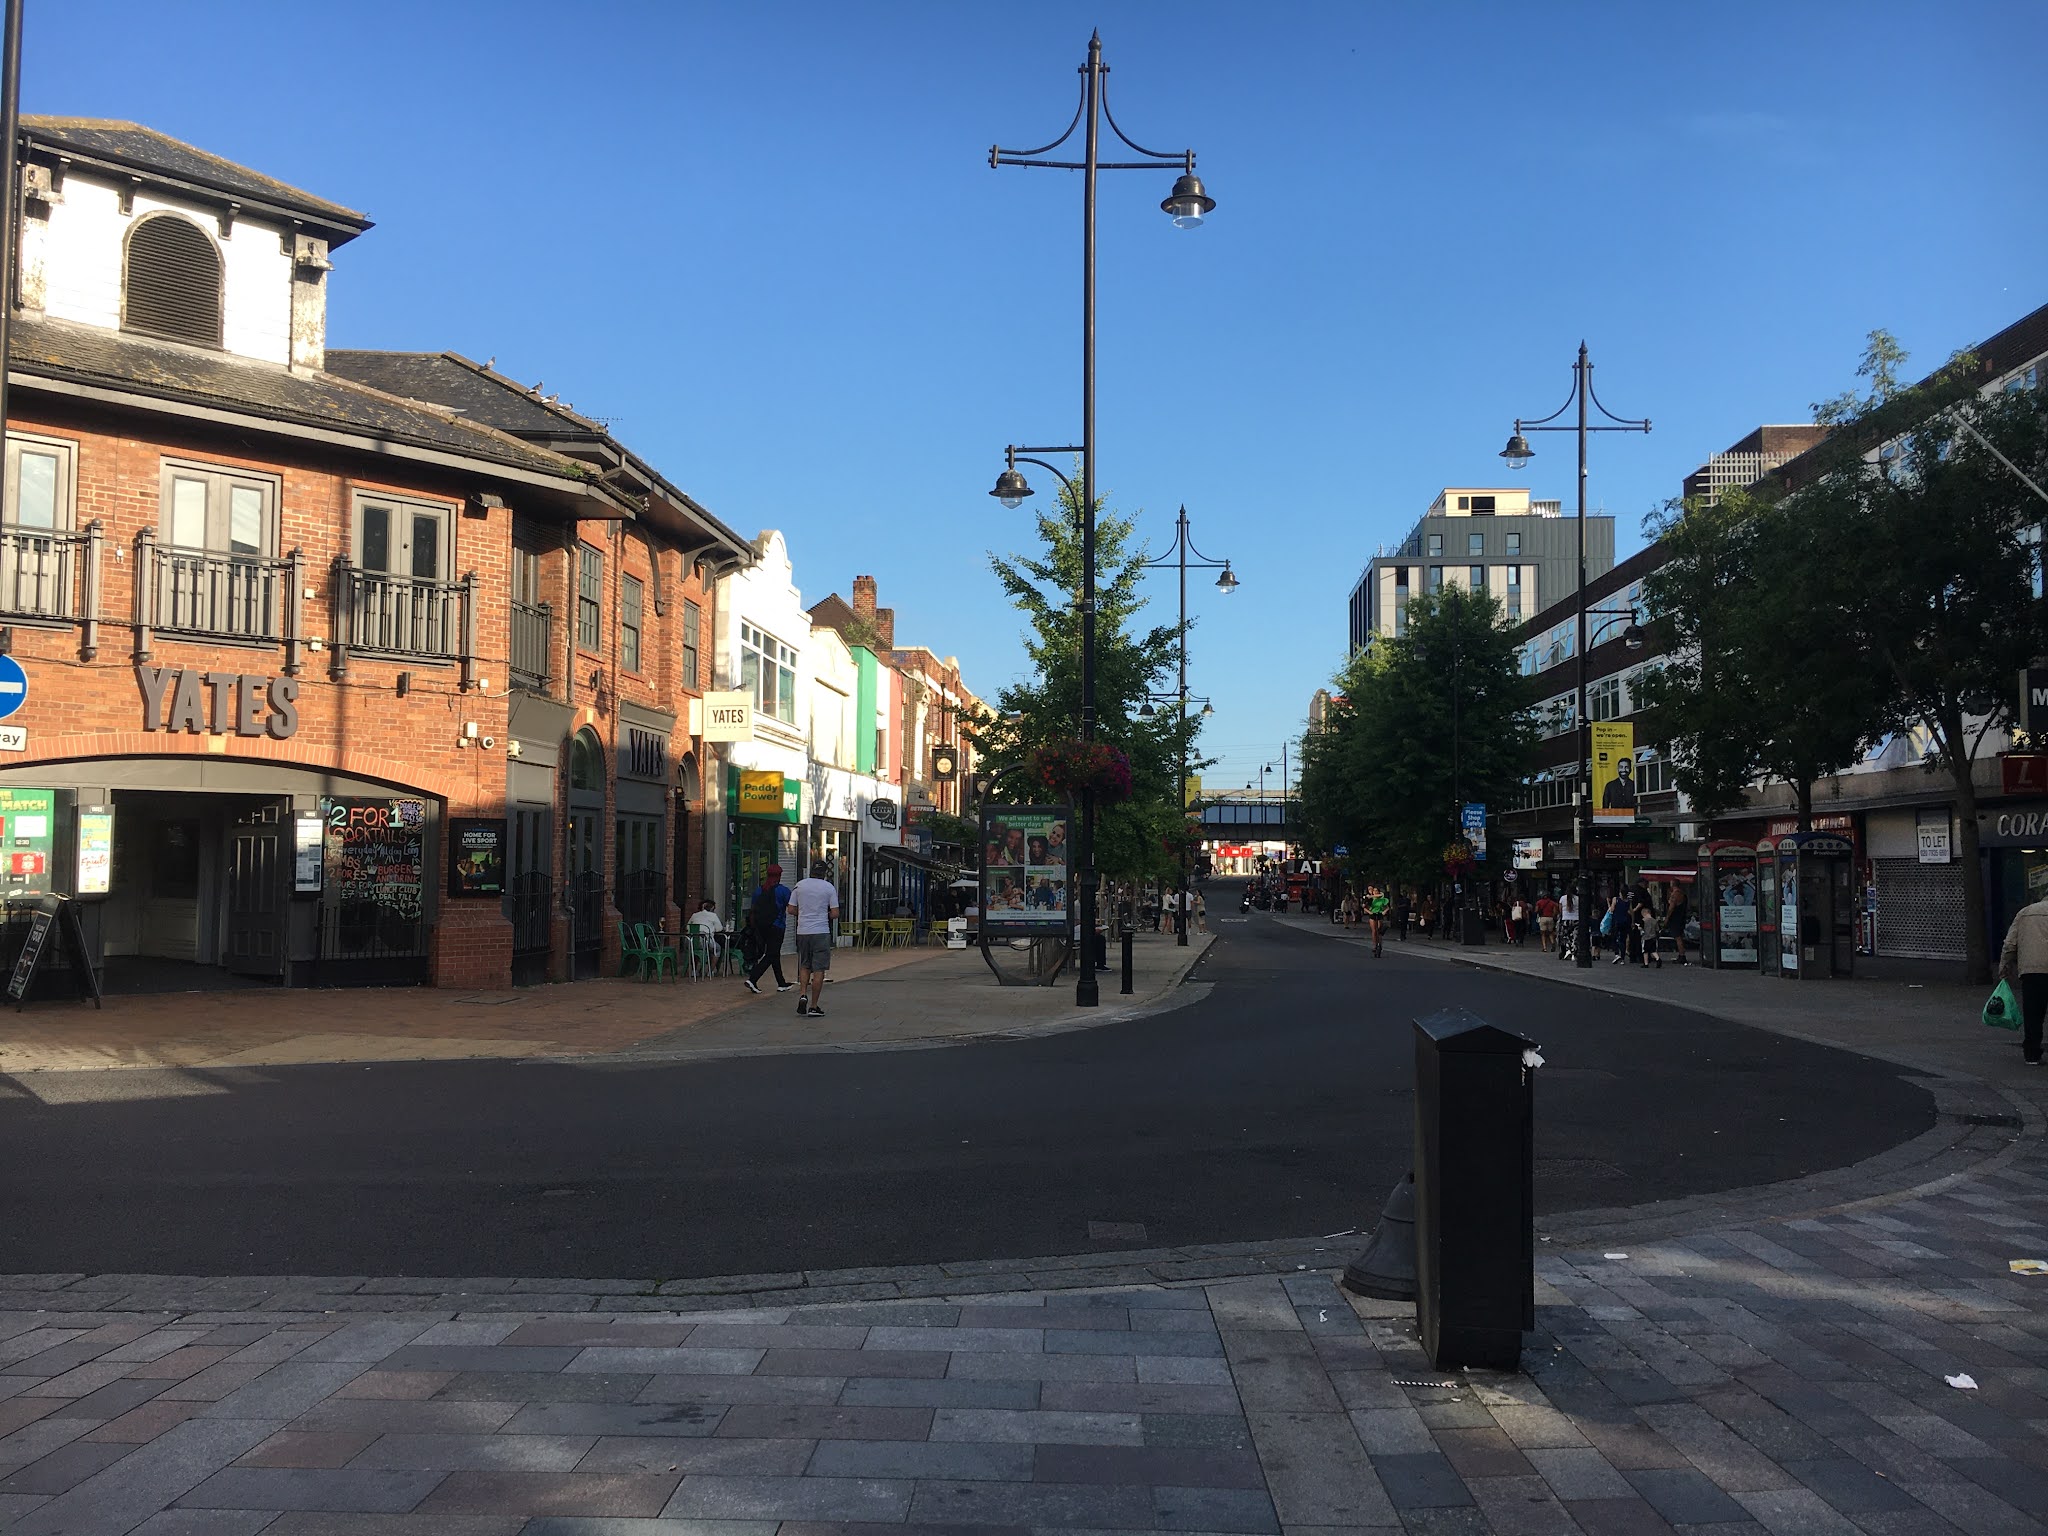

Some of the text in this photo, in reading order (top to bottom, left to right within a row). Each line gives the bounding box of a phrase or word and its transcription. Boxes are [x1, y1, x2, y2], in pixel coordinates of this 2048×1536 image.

[137, 665, 299, 740] YATES
[712, 709, 744, 723] YATES
[0, 734, 21, 746] ay
[629, 728, 665, 777] YATES
[744, 783, 778, 793] Paddy
[743, 792, 778, 801] Power
[1, 800, 48, 811] MATCH
[331, 806, 404, 828] 2 FOR 1
[333, 826, 407, 843] COCKTAILS
[1921, 836, 1946, 847] TO LET
[328, 868, 367, 880] 2 FOR £5
[378, 864, 411, 875] BURGER
[394, 874, 418, 883] DRINK
[399, 886, 417, 894] CLUB
